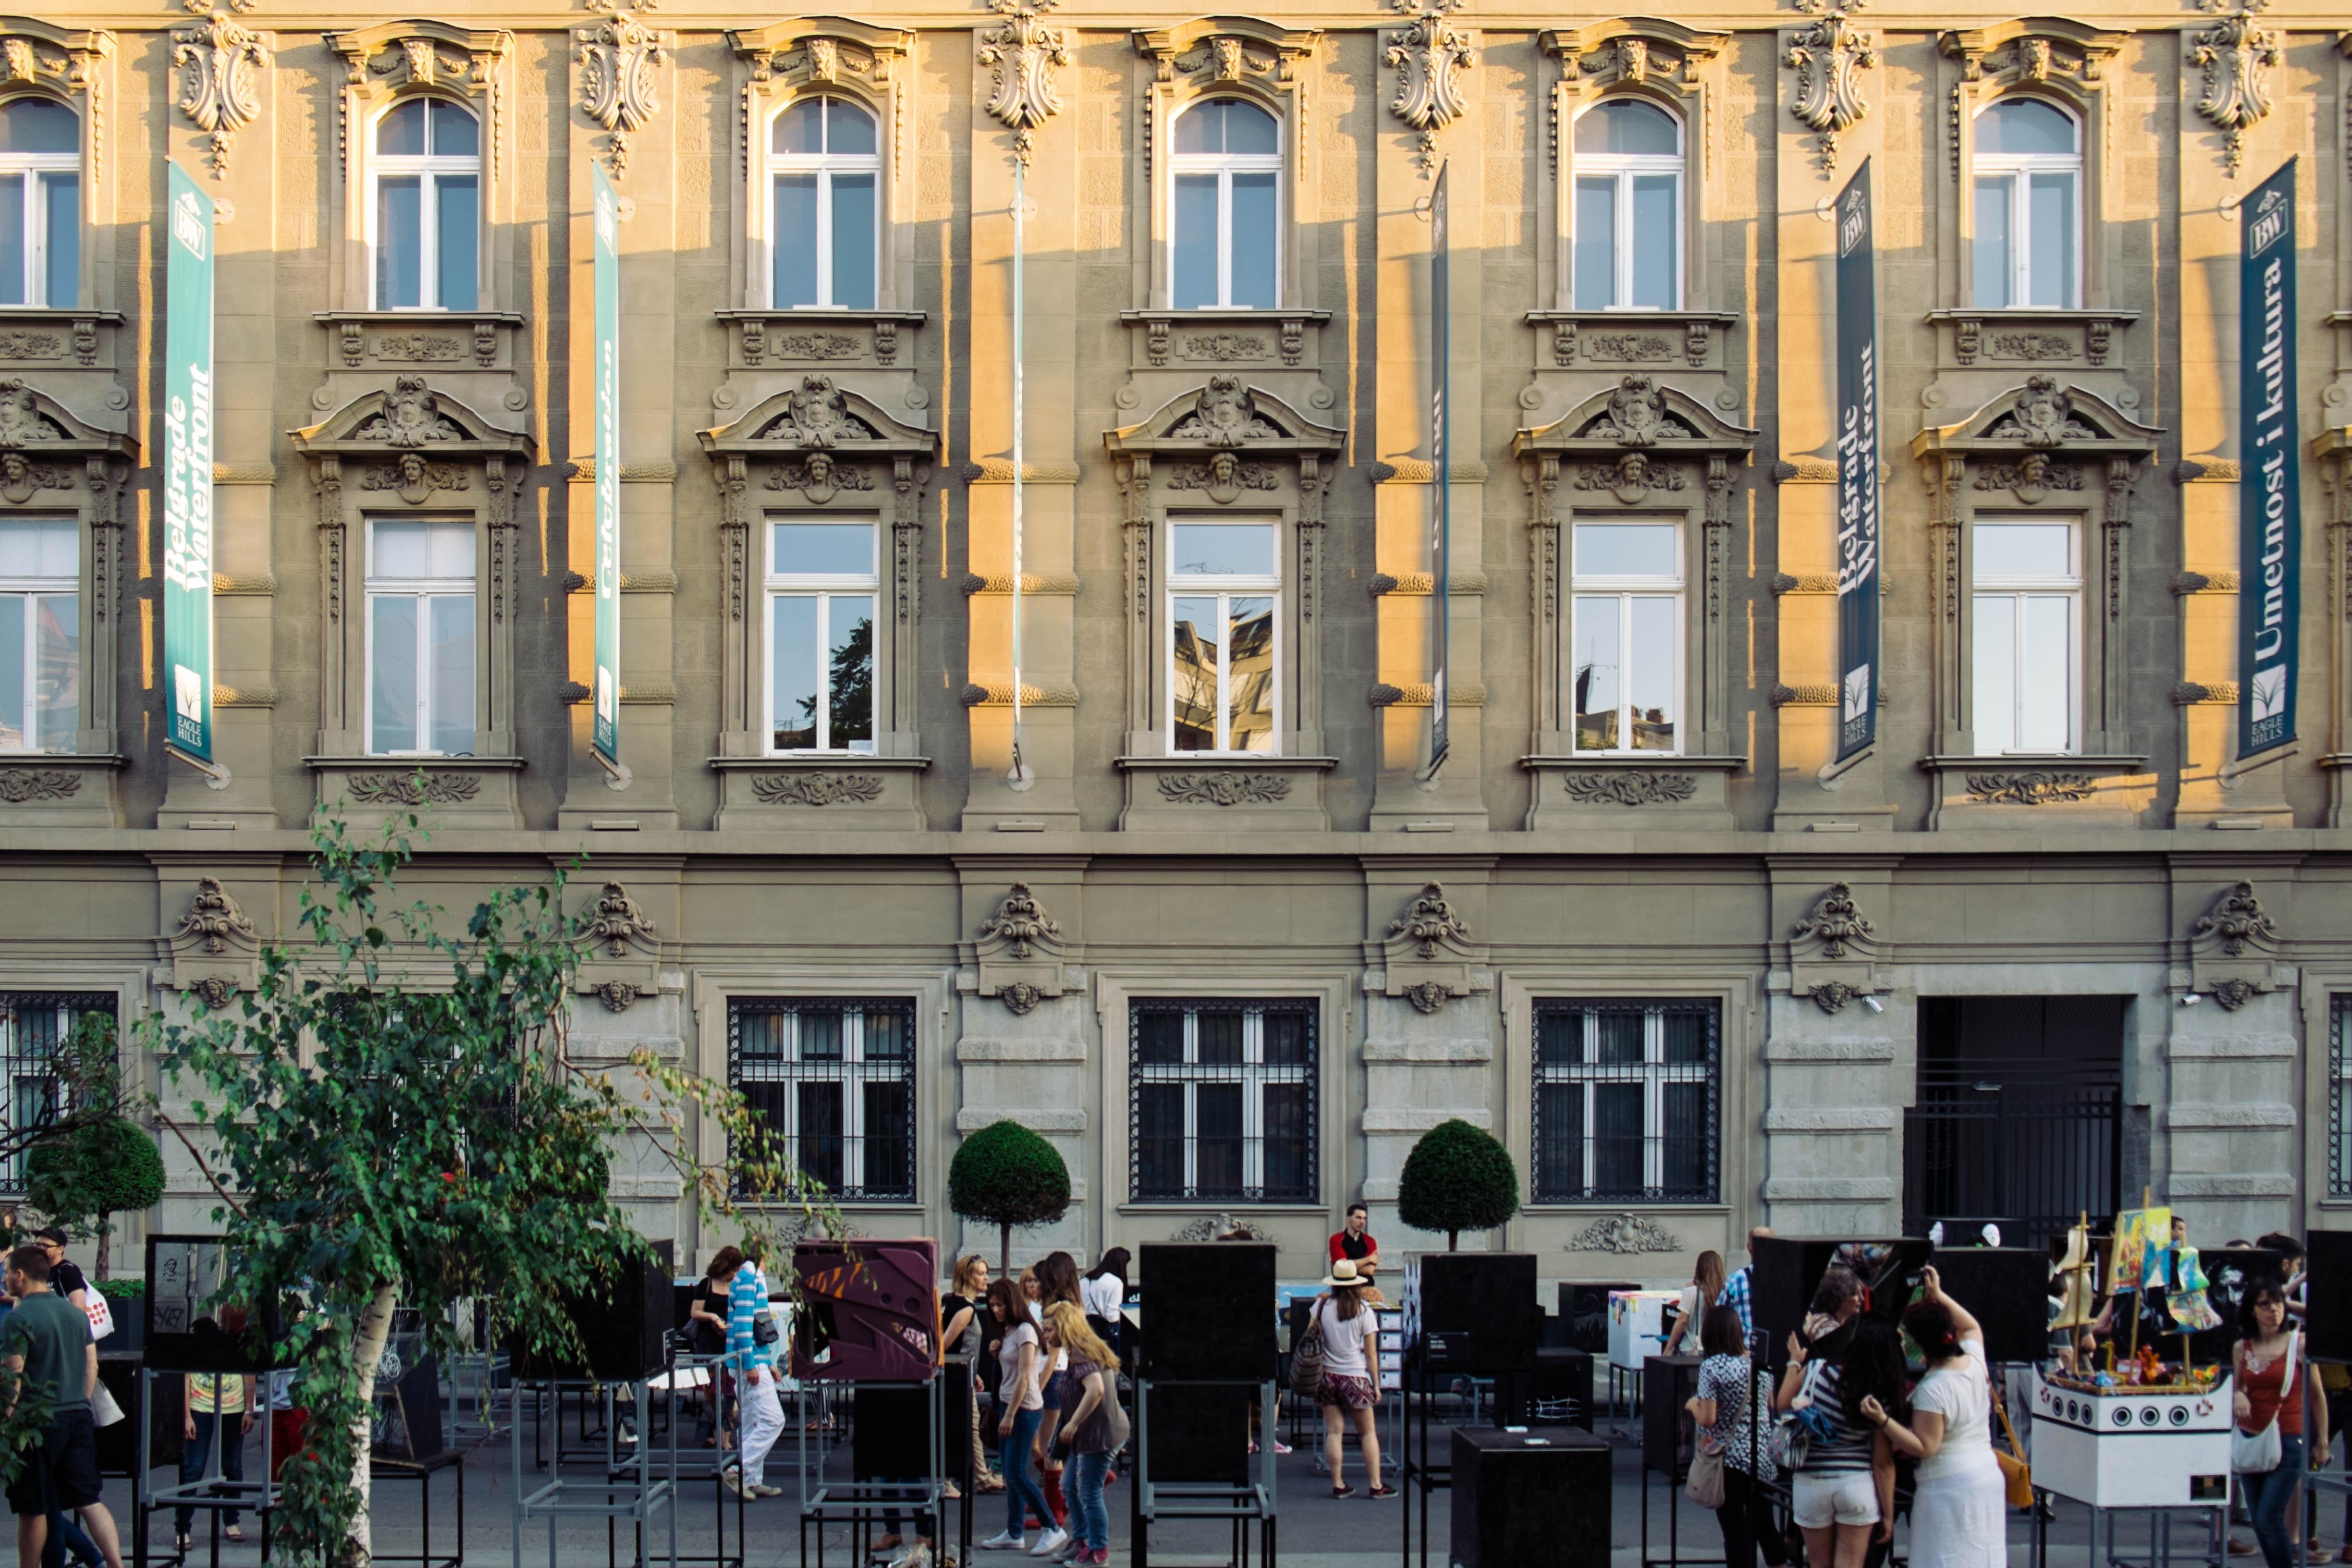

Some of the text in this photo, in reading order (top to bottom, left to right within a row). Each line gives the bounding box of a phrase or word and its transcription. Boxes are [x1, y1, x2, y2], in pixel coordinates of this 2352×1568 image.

[178, 206, 202, 250] BW
[1844, 205, 1864, 251] BW
[2254, 206, 2283, 252] BW
[165, 395, 189, 592] Belgrade
[185, 363, 208, 592] Waterfront
[600, 340, 613, 599] Celebration
[1838, 405, 1860, 600] Belgrade
[1858, 338, 1875, 589] Waterfront
[2254, 257, 2284, 664] Umetnost i kultura
[178, 715, 201, 736] EAGLE
[178, 726, 202, 747] HILLS
[2251, 726, 2283, 747] HILLS
